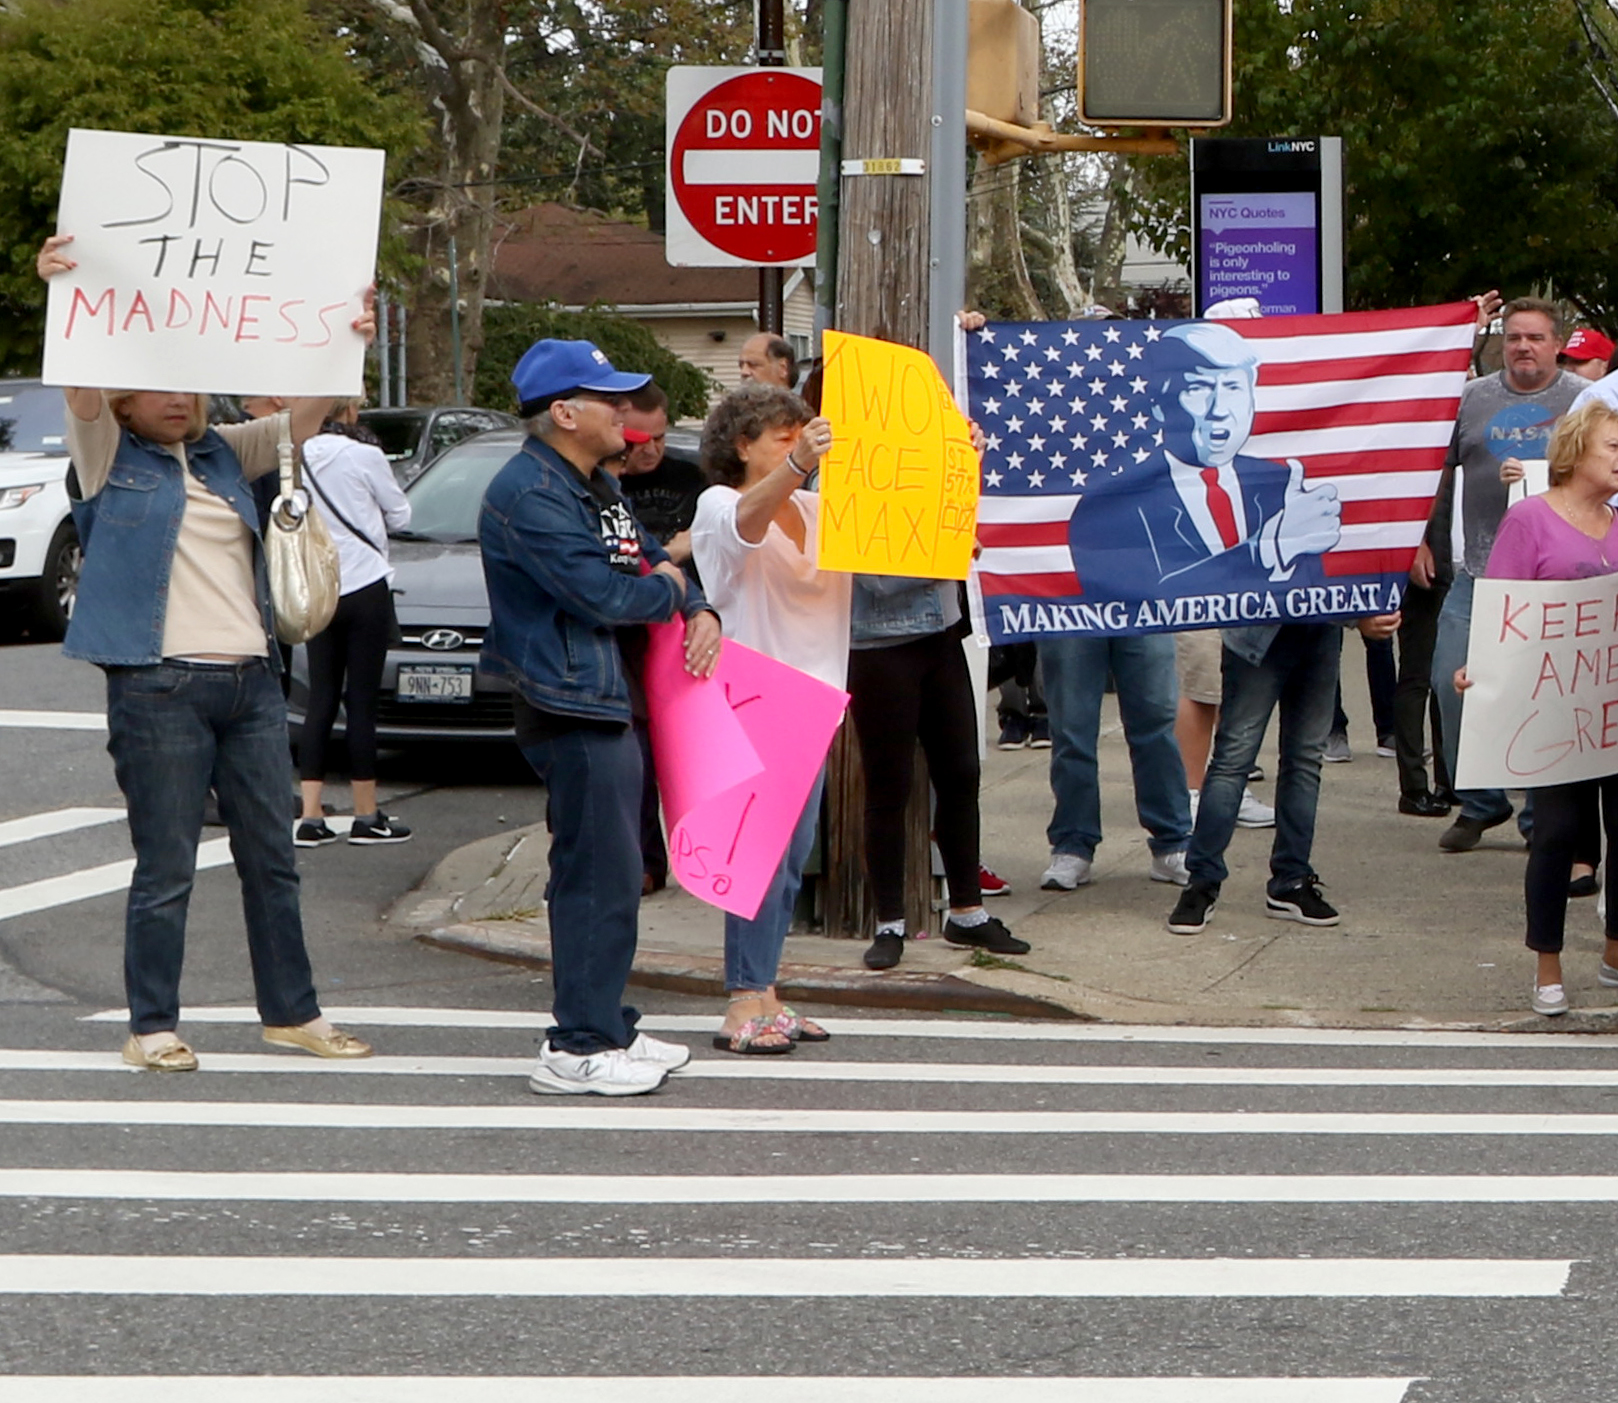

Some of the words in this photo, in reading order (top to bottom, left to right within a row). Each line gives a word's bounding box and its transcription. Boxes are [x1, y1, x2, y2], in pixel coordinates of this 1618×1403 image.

[706, 109, 752, 139] DO
[1268, 141, 1315, 153] LinkNYC
[101, 141, 330, 228] STOP
[1209, 208, 1237, 219] NYC
[1240, 207, 1286, 219] Quotes
[138, 235, 275, 278] THE
[1209, 257, 1220, 268] is
[1222, 256, 1249, 271] only
[1209, 270, 1274, 285] interesting
[1277, 270, 1290, 281] to
[64, 287, 348, 348] MADNESS
[1260, 304, 1297, 314] orman
[824, 339, 932, 435] TWO
[825, 437, 930, 492] FACE
[822, 493, 929, 564] MAX
[999, 599, 1128, 635] MAKING
[1133, 590, 1281, 627] AMERICA
[1285, 583, 1381, 617] GREAT
